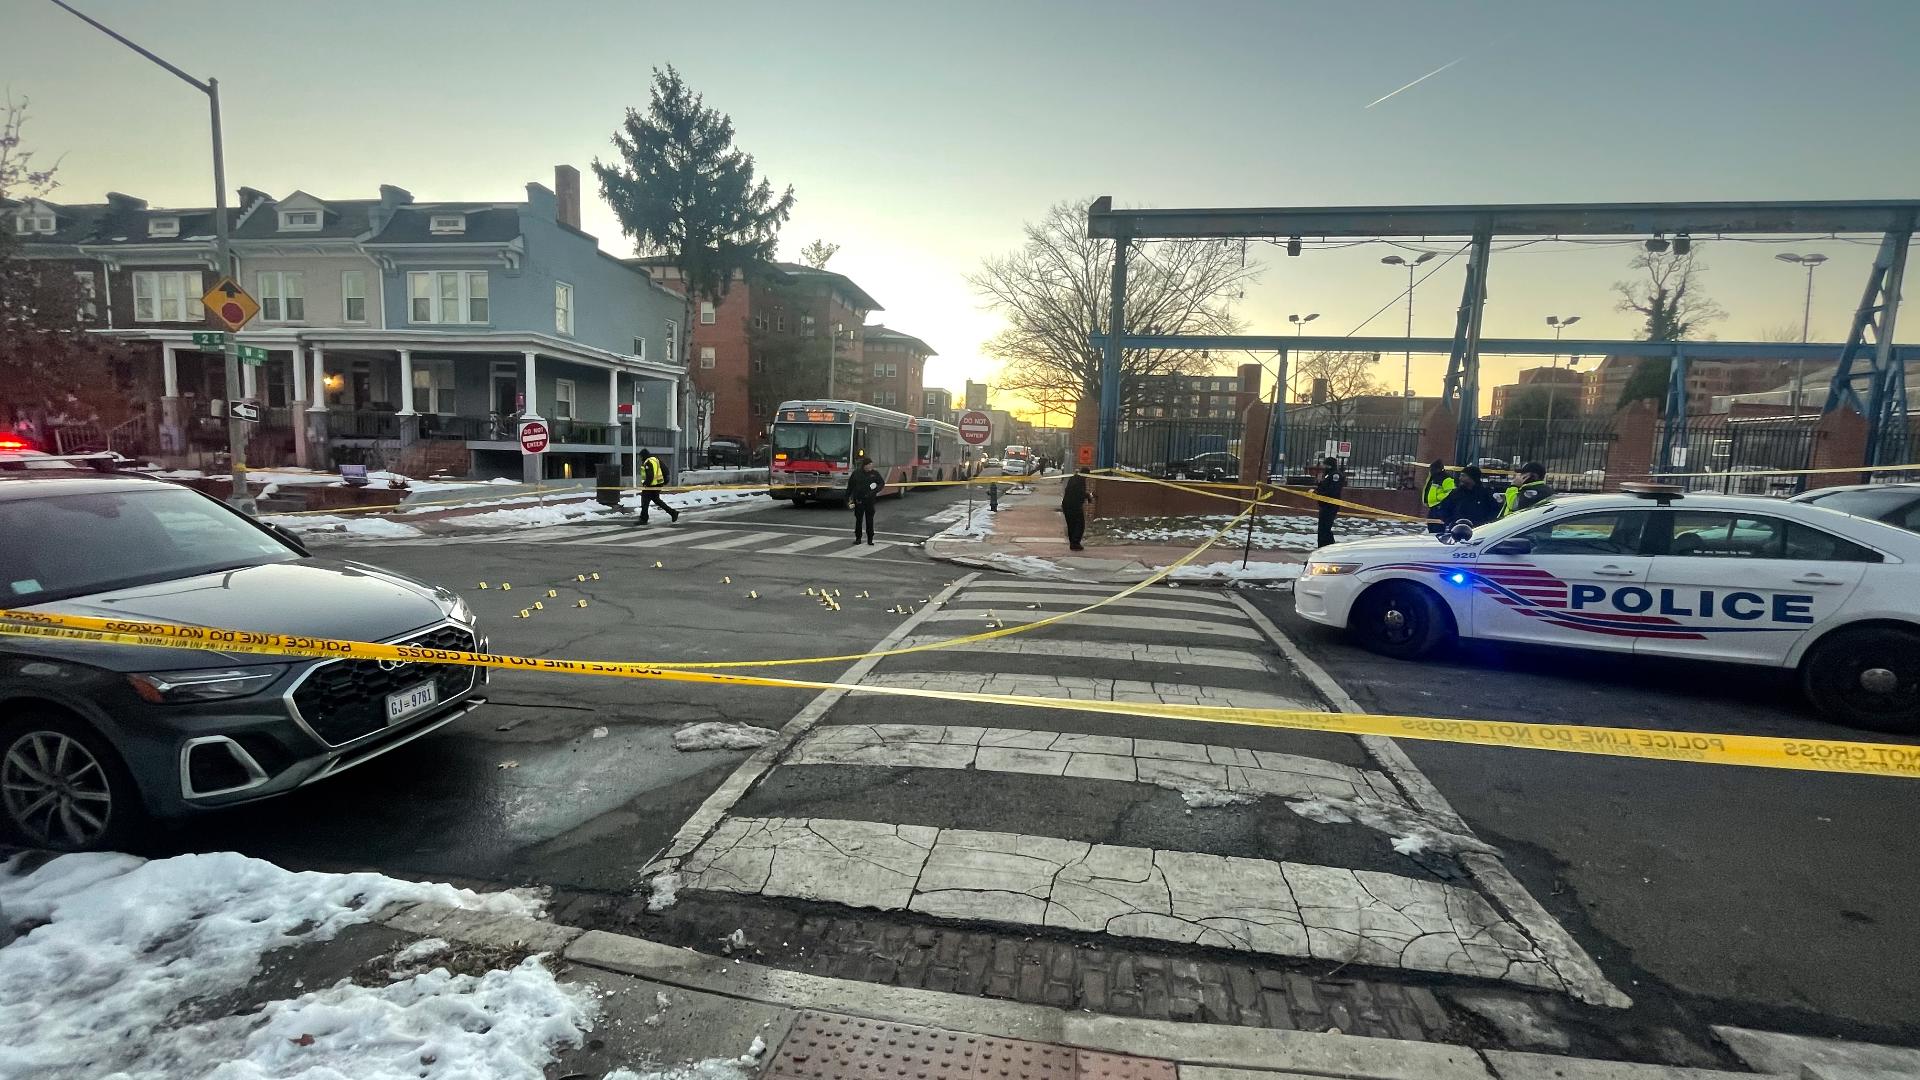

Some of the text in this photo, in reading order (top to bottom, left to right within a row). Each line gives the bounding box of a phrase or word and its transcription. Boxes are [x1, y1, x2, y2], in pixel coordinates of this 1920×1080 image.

[1571, 584, 1814, 623] POLICE
[210, 630, 235, 642] DO
[242, 632, 280, 646] LINE
[285, 637, 351, 652] POLICE
[396, 646, 460, 661] CROSS
[391, 688, 433, 716] GJ 9781
